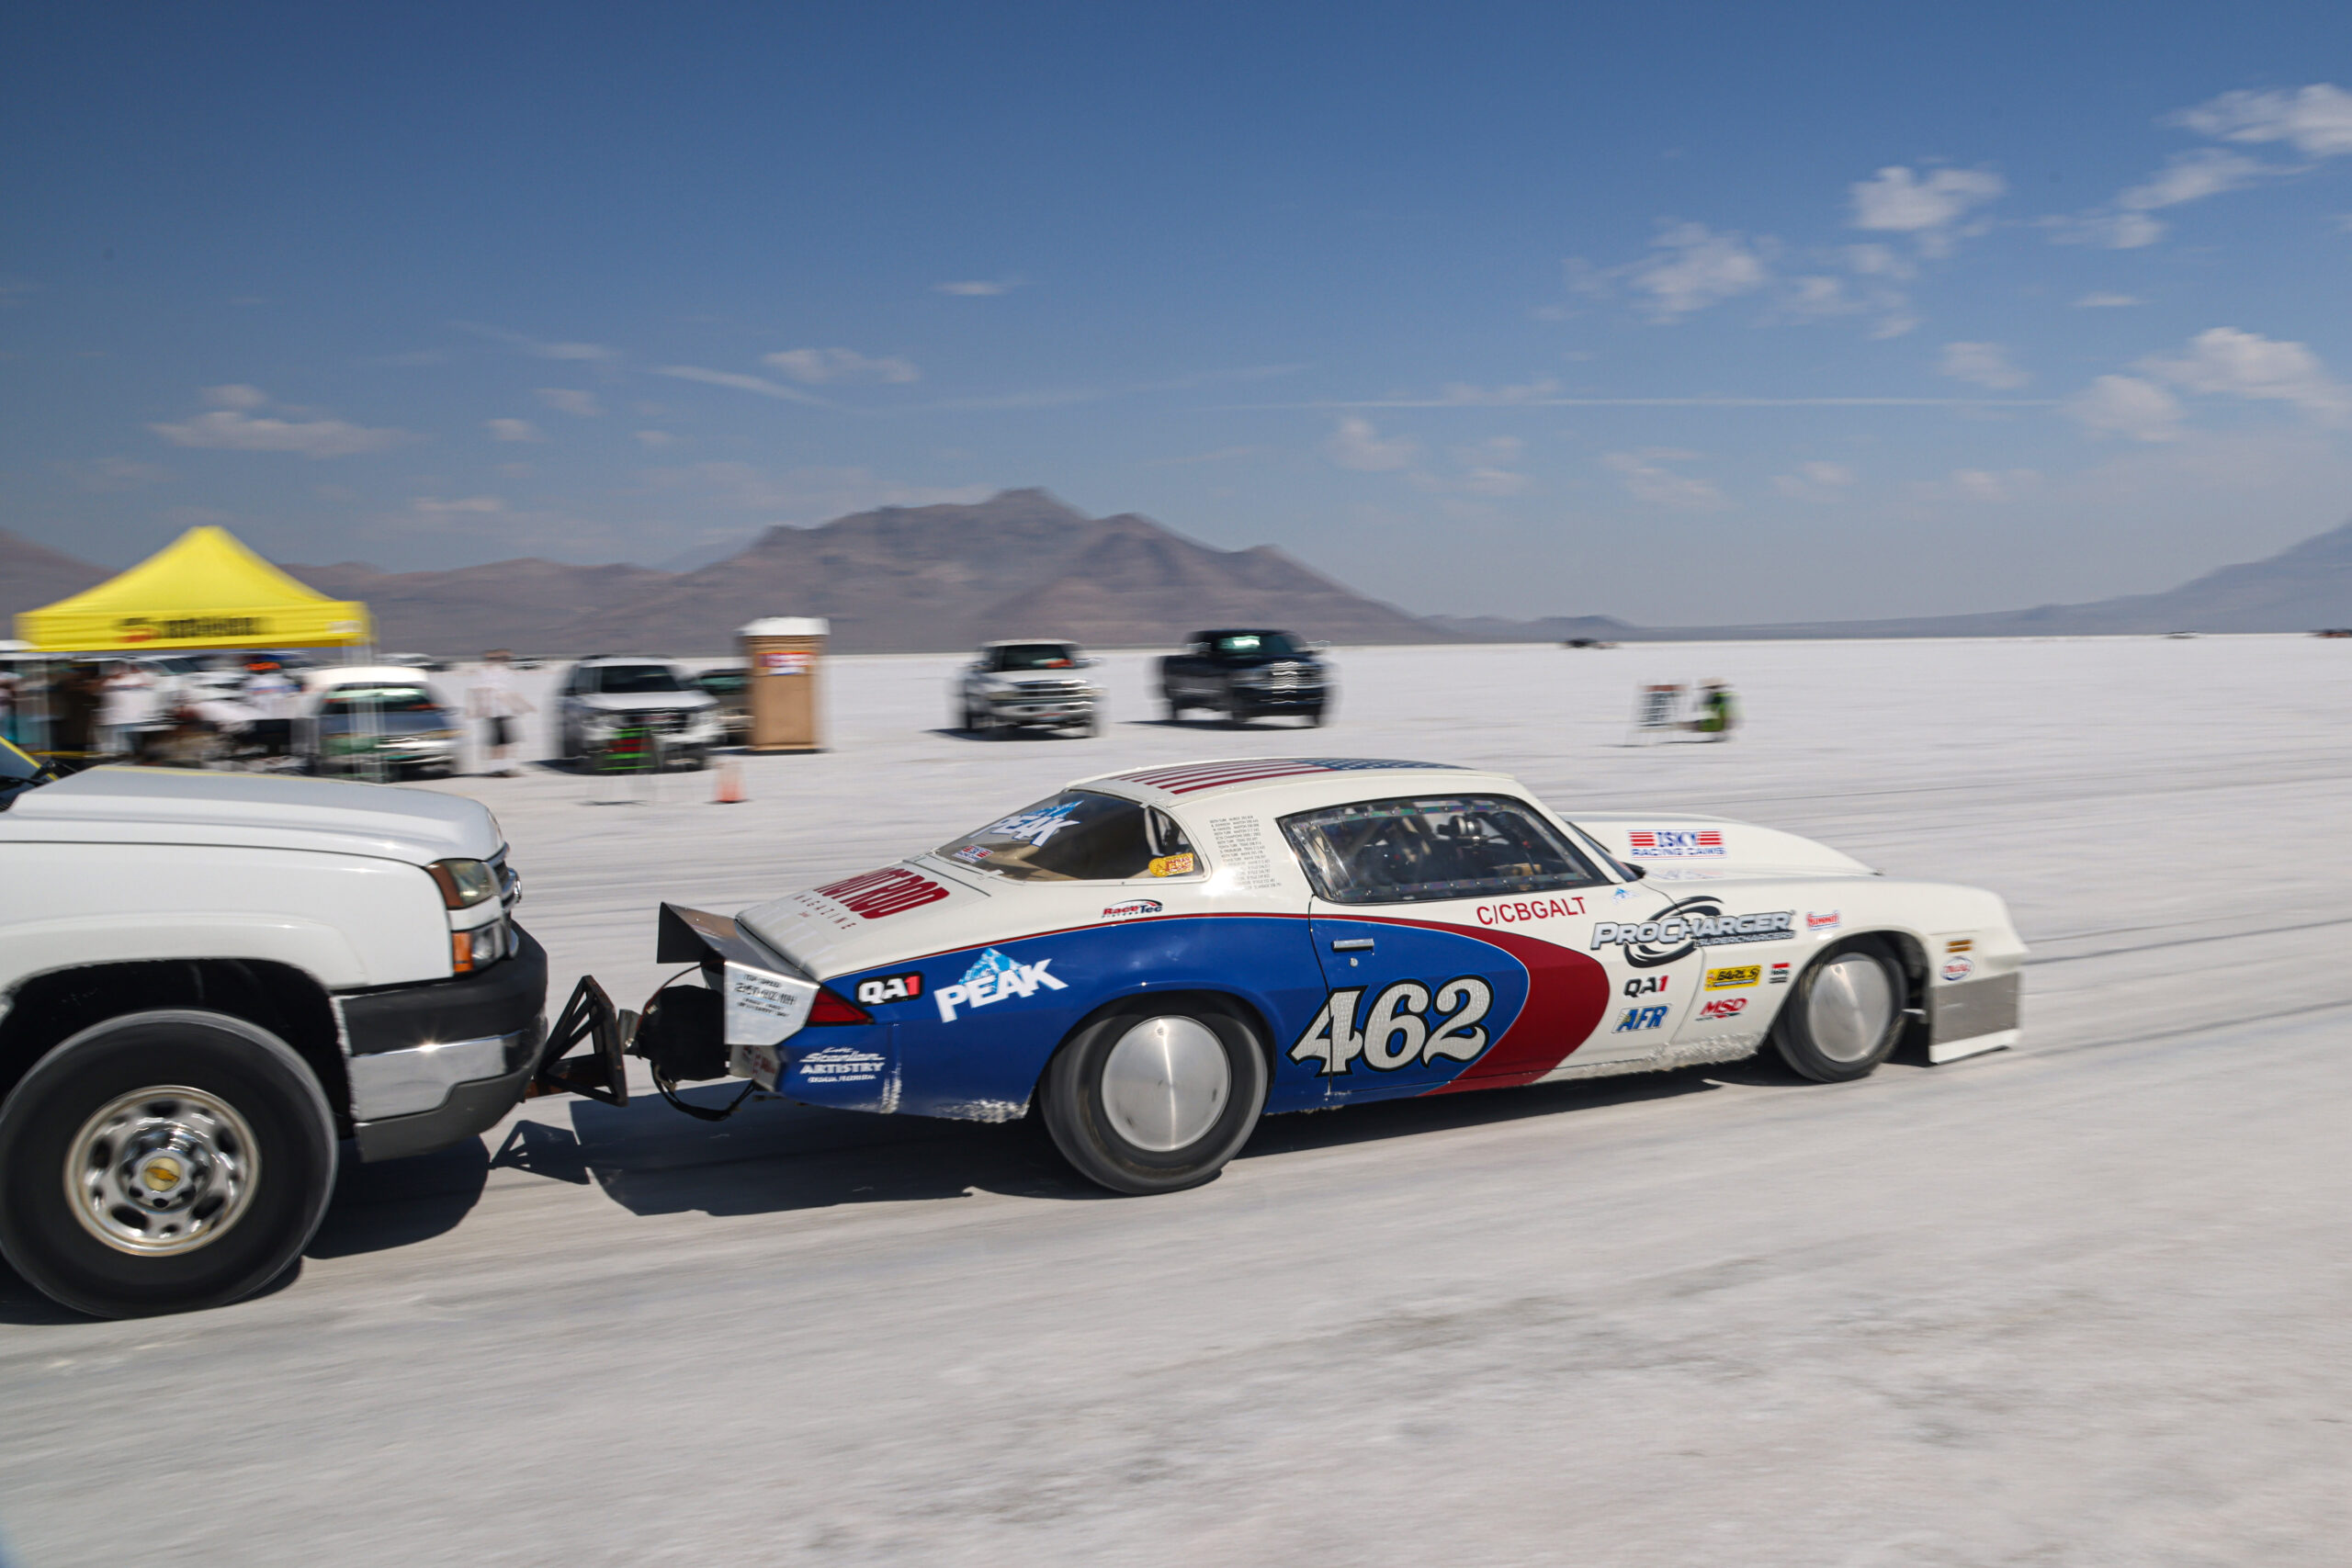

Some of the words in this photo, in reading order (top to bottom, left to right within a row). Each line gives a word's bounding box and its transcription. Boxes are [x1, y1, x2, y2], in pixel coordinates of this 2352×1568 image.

[968, 815, 1081, 847] PEAK
[1656, 830, 1697, 847] ISKY
[1632, 848, 1682, 856] RACING
[839, 874, 950, 919] ROD
[794, 895, 856, 930] MAGAZINE
[1476, 897, 1586, 925] C/CBGALT
[858, 976, 921, 1004] QA1
[933, 958, 1069, 1023] PEAK
[1623, 975, 1668, 998] QA1
[1615, 1006, 1668, 1031] AFR
[1700, 998, 1747, 1015] MSD
[1286, 975, 1494, 1077] 462
[799, 1063, 885, 1074] ARTISTRY
